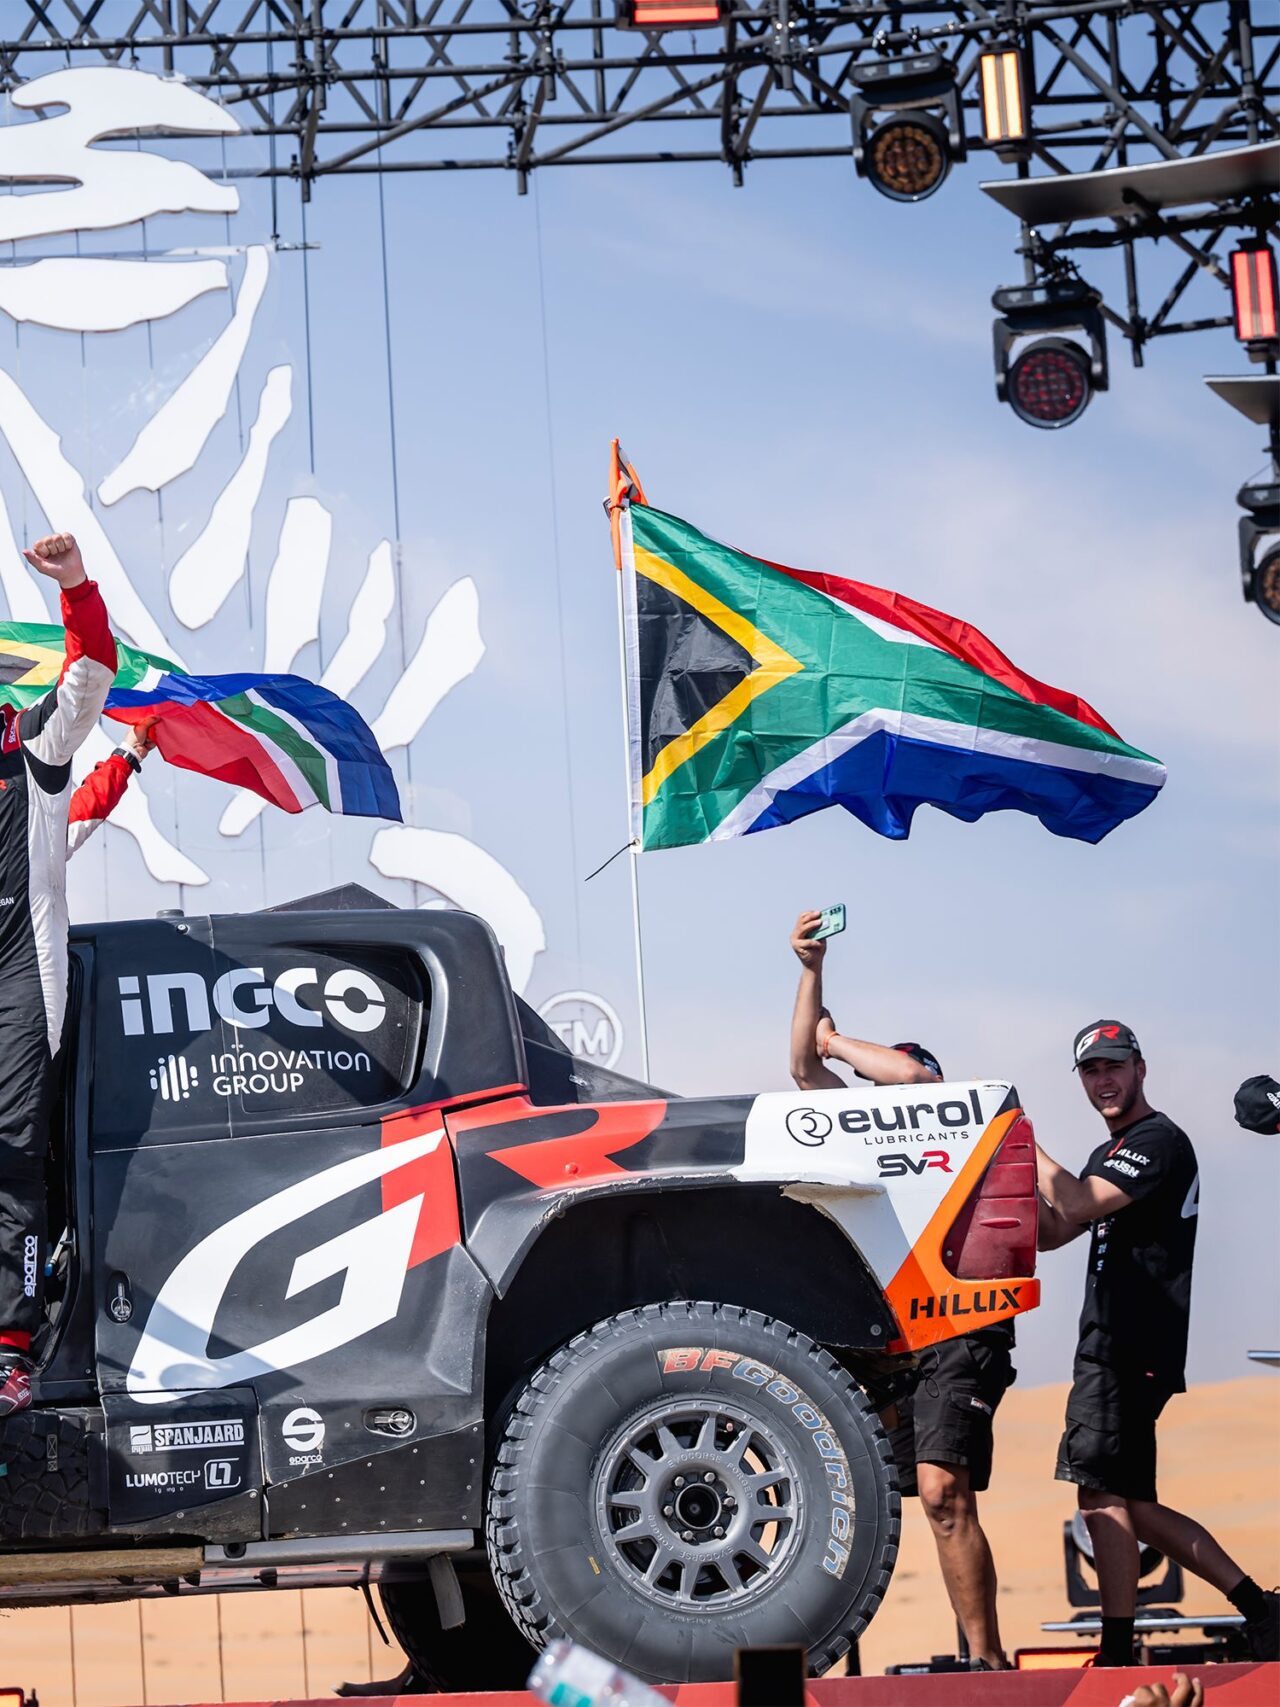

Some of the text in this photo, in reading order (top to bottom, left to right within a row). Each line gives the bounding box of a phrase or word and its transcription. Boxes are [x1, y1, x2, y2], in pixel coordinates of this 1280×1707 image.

[1076, 1025, 1120, 1060] GR
[213, 1073, 304, 1096] GROUP
[838, 1089, 984, 1134] eurol
[864, 1131, 969, 1146] LUBRICANTS
[877, 1150, 954, 1178] SVR
[126, 1083, 668, 1405] GR
[25, 1235, 38, 1297] sparco
[910, 1286, 1023, 1320] HILUX
[154, 1424, 244, 1447] SPANJAARD
[289, 1454, 322, 1466] sparco
[663, 1350, 850, 1574] BFGoodrich
[126, 1470, 201, 1488] LUMOTECH
[727, 1462, 753, 1498] FORGED
